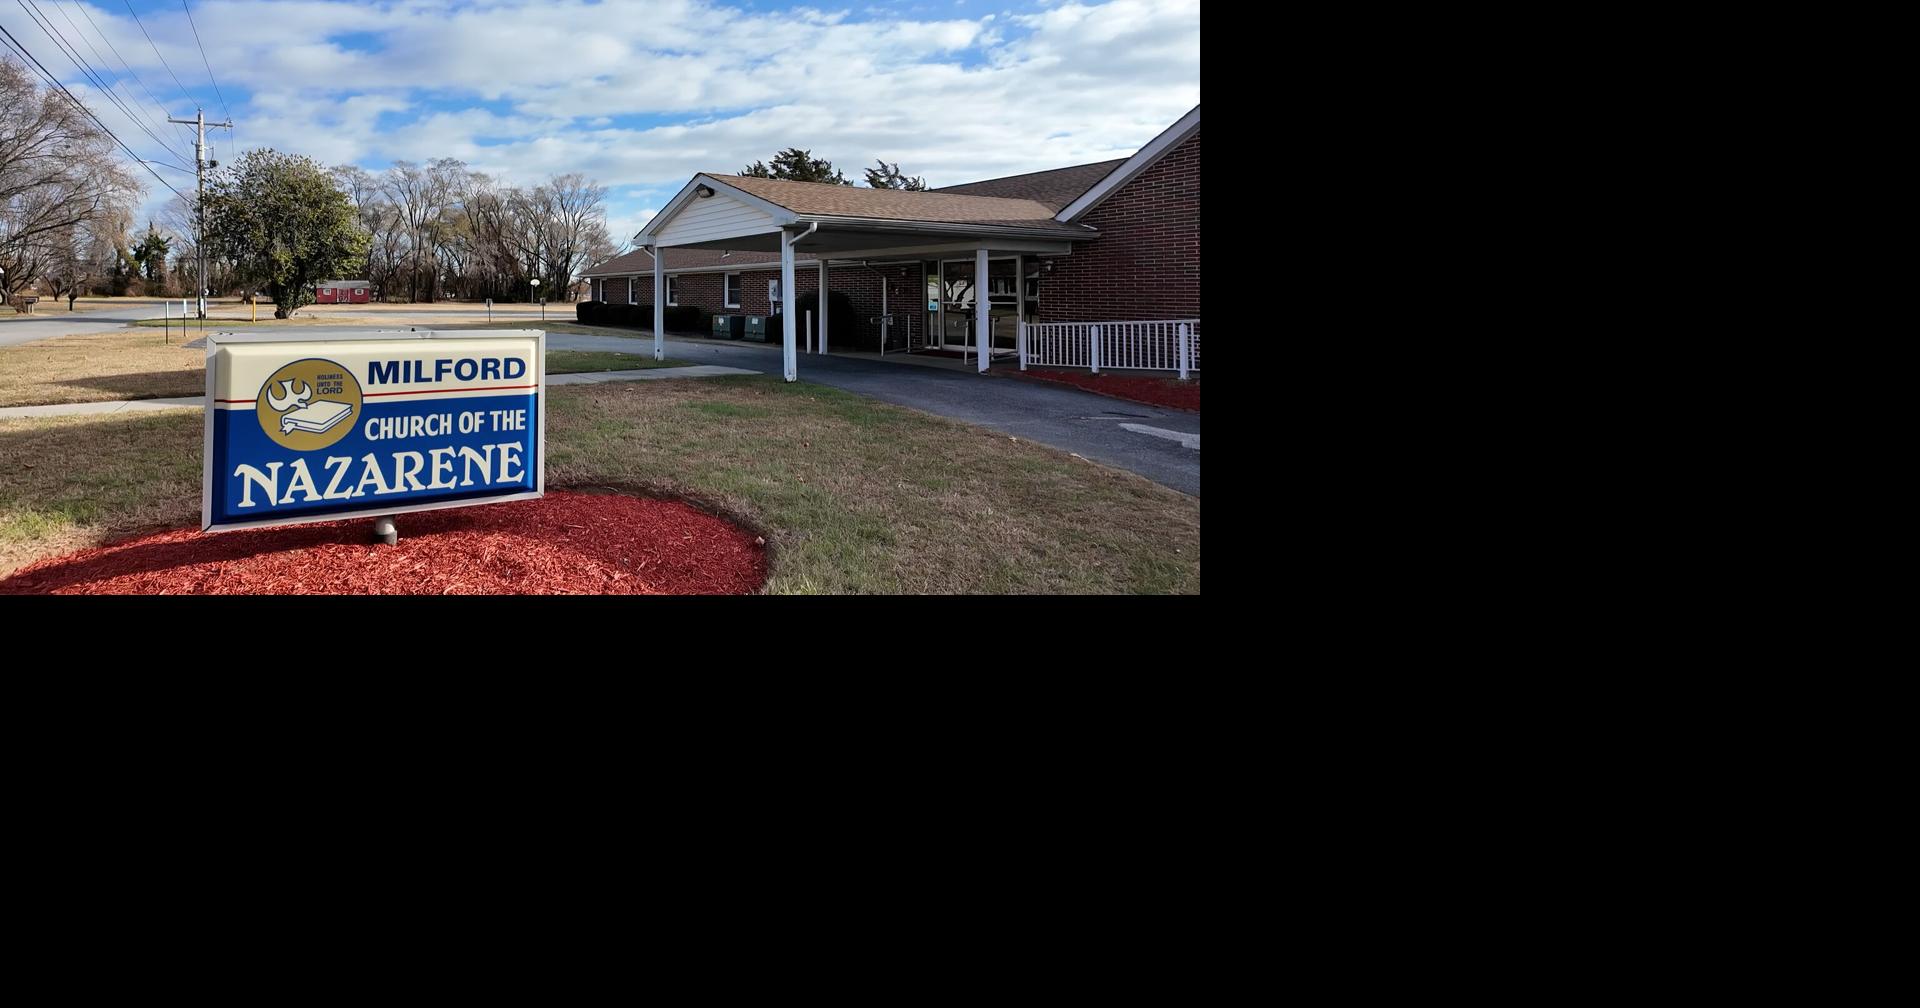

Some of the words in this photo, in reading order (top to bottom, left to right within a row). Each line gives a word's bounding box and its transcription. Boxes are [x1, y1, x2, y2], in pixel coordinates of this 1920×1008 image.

[368, 357, 526, 385] MILFORD
[316, 387, 343, 395] LORD
[364, 413, 452, 441] CHURCH
[458, 411, 485, 434] OF
[489, 409, 526, 432] THE
[233, 441, 525, 507] NAZARENE
